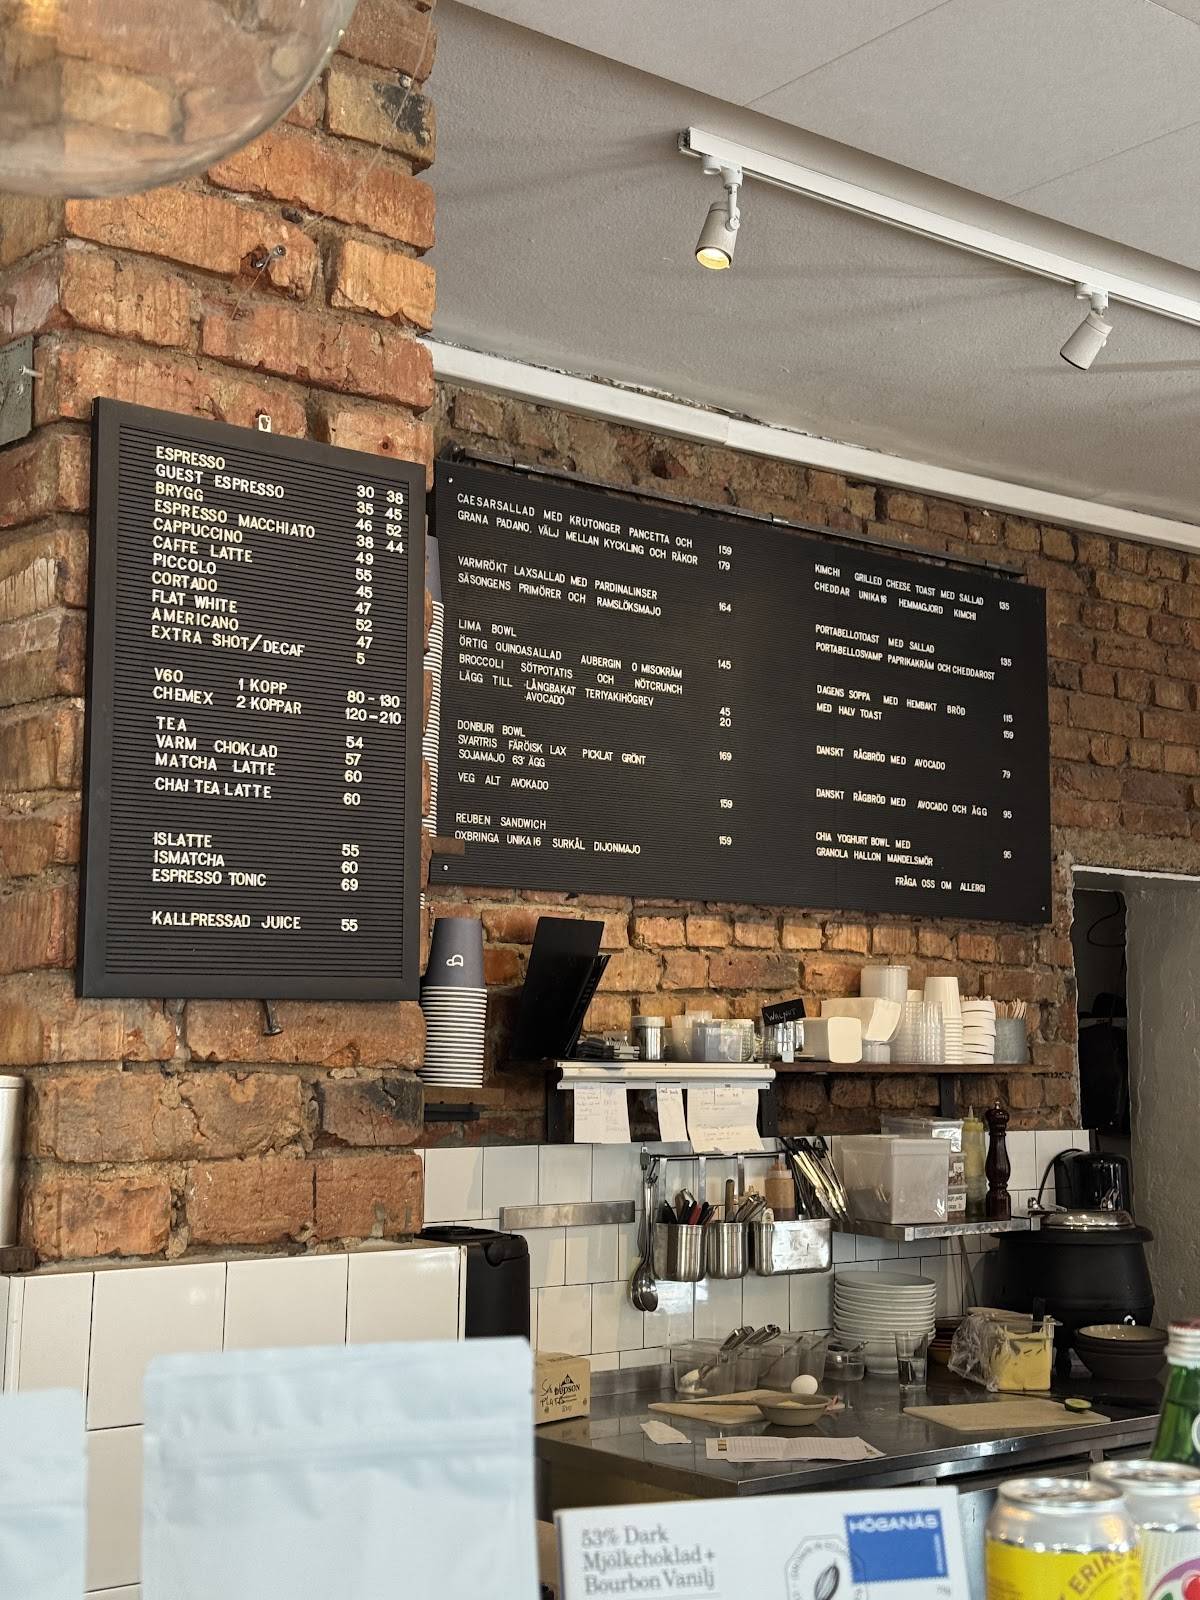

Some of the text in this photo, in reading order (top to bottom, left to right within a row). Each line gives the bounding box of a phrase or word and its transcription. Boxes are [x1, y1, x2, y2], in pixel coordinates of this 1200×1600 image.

[156, 446, 225, 470] ESPRESSO
[154, 464, 284, 498] GUEST ESPRESSO
[155, 481, 203, 502] BRYGG
[356, 485, 404, 505] 30 38
[154, 499, 315, 538] ESPRESSO MACCHIATO
[356, 501, 402, 521] 35 45
[457, 493, 670, 544] CAESARSALLAD KRUTONGER PANCETTA
[153, 517, 243, 543] CAPPUCCINO
[355, 518, 402, 537] 46 52
[458, 510, 489, 525] GRANA
[538, 524, 559, 538] VÄLJ
[566, 531, 599, 546] MELLAN
[604, 538, 644, 555] KYCKLING
[152, 535, 253, 563] CAFFE LATTE
[356, 535, 404, 554] 38 44
[719, 545, 732, 555] 159
[153, 552, 216, 575] PICCOLO
[355, 552, 374, 565] 49
[718, 560, 730, 571] 179
[152, 571, 217, 592] CORTADO
[355, 568, 372, 582] 55
[458, 556, 657, 600] VARMRÖKT LAXSALLAD PARDINALINSER
[458, 572, 511, 591] SÄSONGENS
[355, 585, 373, 599] 45
[814, 581, 850, 597] CHEDDAR
[815, 564, 840, 577] KIMCHI
[854, 572, 882, 586] GRILLED
[915, 585, 936, 596] TOAST
[959, 593, 984, 605] SALLAD
[152, 589, 237, 613] FLAT WHITE
[354, 602, 372, 615] 47
[719, 602, 732, 612] 164
[151, 607, 239, 631] AMERICANO
[355, 618, 372, 632] 52
[151, 625, 202, 644] EXTRA
[459, 619, 517, 637] LIMA BOWL
[356, 636, 373, 649] 47
[356, 652, 365, 665] 5
[459, 636, 488, 650] ÖRTIG
[495, 642, 562, 660] QUINOASALLAD
[581, 655, 621, 669] AUBERGIN
[459, 653, 504, 669] BROCCOLI
[718, 659, 731, 670] 145
[952, 665, 995, 680] CHEDDAROST
[154, 667, 183, 683] V60
[459, 670, 483, 683] LÄGG
[492, 675, 513, 687] TILL
[249, 678, 287, 695] KOPP
[152, 686, 213, 705] CHEMEX
[817, 685, 966, 716] DAGENS SOPPA HEMBAKT BRÖD
[249, 696, 302, 714] KOPPAR
[719, 707, 731, 716] 45
[720, 717, 731, 727] 20
[860, 709, 882, 720] TOAST
[156, 716, 187, 732] TEA
[457, 720, 526, 737] DONBURI BOWL
[156, 734, 278, 758] VARM CHOKLAD
[346, 736, 364, 749] 54
[458, 734, 497, 748] SVARTRIS
[550, 745, 567, 756] LAX
[582, 748, 613, 761] PICKLAT
[155, 752, 276, 775] MATCHA LATTE
[345, 753, 361, 766] 57
[458, 749, 545, 767] SOJAMAJO ÄGG
[719, 751, 732, 761] 169
[816, 745, 844, 757] DANSKT
[914, 758, 946, 770] AVOCADO
[344, 770, 362, 783] 60
[458, 772, 549, 790] VEG ALT AVOKADO
[153, 777, 272, 799] CHAI TEA LATTE
[343, 792, 360, 805] 60
[720, 799, 733, 809] 159
[816, 788, 844, 800] DANSKT
[917, 800, 948, 812] AVOCADO
[972, 805, 987, 816] ÄGG
[456, 813, 546, 830] REUBEN SANDWICH
[152, 832, 212, 848] ISLATTE
[455, 830, 641, 854] OXBRINGA SURKÅL DIJONMAJO
[719, 836, 732, 845] 159
[816, 832, 890, 847] CHIA YOGHURT BOWL
[154, 850, 225, 867] ISMATCHA
[341, 844, 360, 857] 55
[816, 847, 848, 858] GRANOLA
[854, 850, 881, 861] HALLON
[341, 861, 358, 874] 60
[152, 869, 266, 886] ESPRESSO TONIC
[341, 878, 358, 891] 69
[895, 875, 985, 892] FRÅGA ALLERGI
[151, 911, 301, 929] KALLPRESSAD JUICE
[341, 919, 358, 932] 55
[581, 1524, 669, 1547] 53% Dark
[585, 1566, 716, 1595] Bourbon Vanilj
